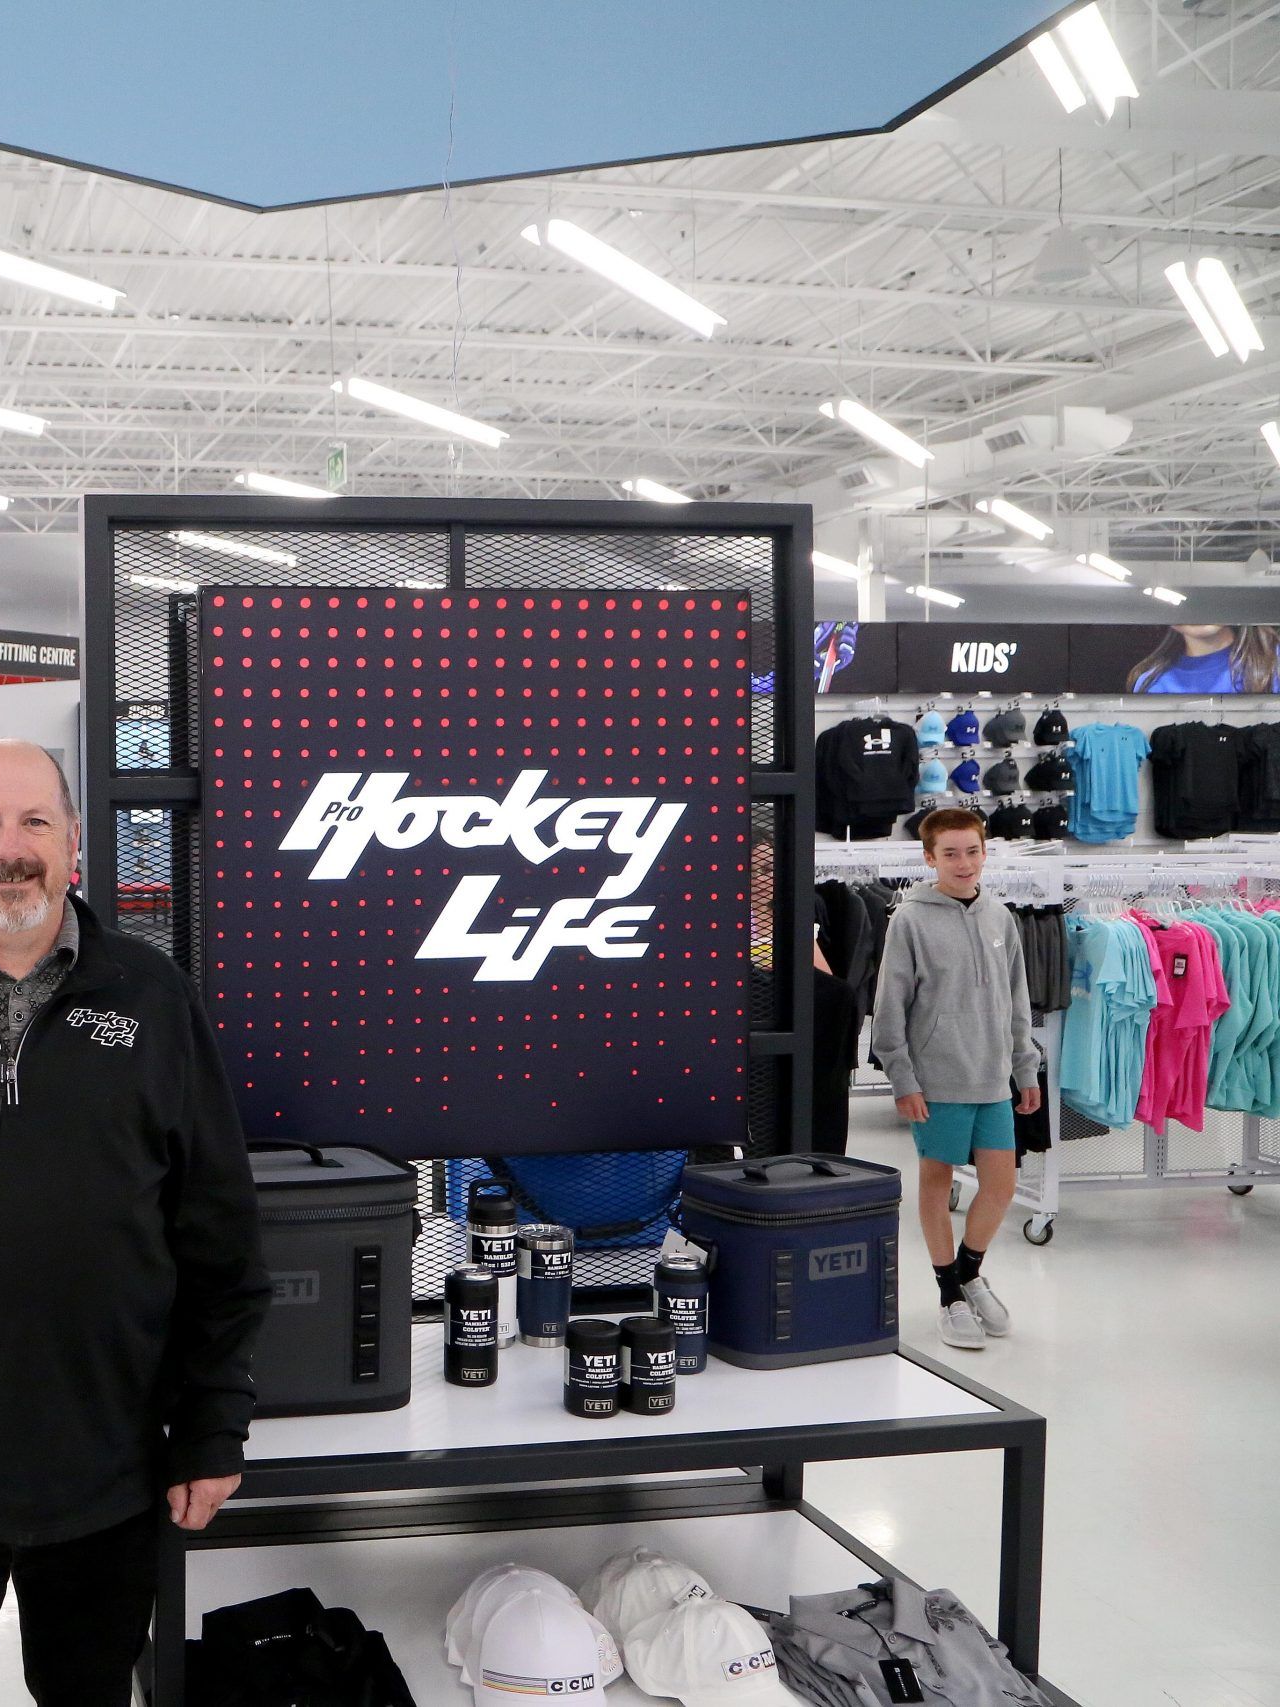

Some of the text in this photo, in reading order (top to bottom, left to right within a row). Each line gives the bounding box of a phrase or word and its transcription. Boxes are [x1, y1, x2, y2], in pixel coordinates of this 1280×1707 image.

[39, 647, 76, 667] CENTRE
[951, 642, 1017, 673] KIDS'
[320, 801, 364, 822] Pro
[480, 1239, 514, 1252] YETI
[542, 1252, 571, 1265] YETI
[814, 1249, 861, 1272] YETI
[272, 1279, 312, 1298] ETI
[667, 1297, 699, 1309] YETI
[460, 1309, 491, 1320] YETI
[583, 1355, 616, 1367] YETI
[647, 1350, 676, 1364] YETI
[587, 1401, 611, 1410] YETI
[651, 1398, 672, 1406] YETI
[728, 1652, 776, 1675] CCM
[550, 1675, 594, 1692] CCM
